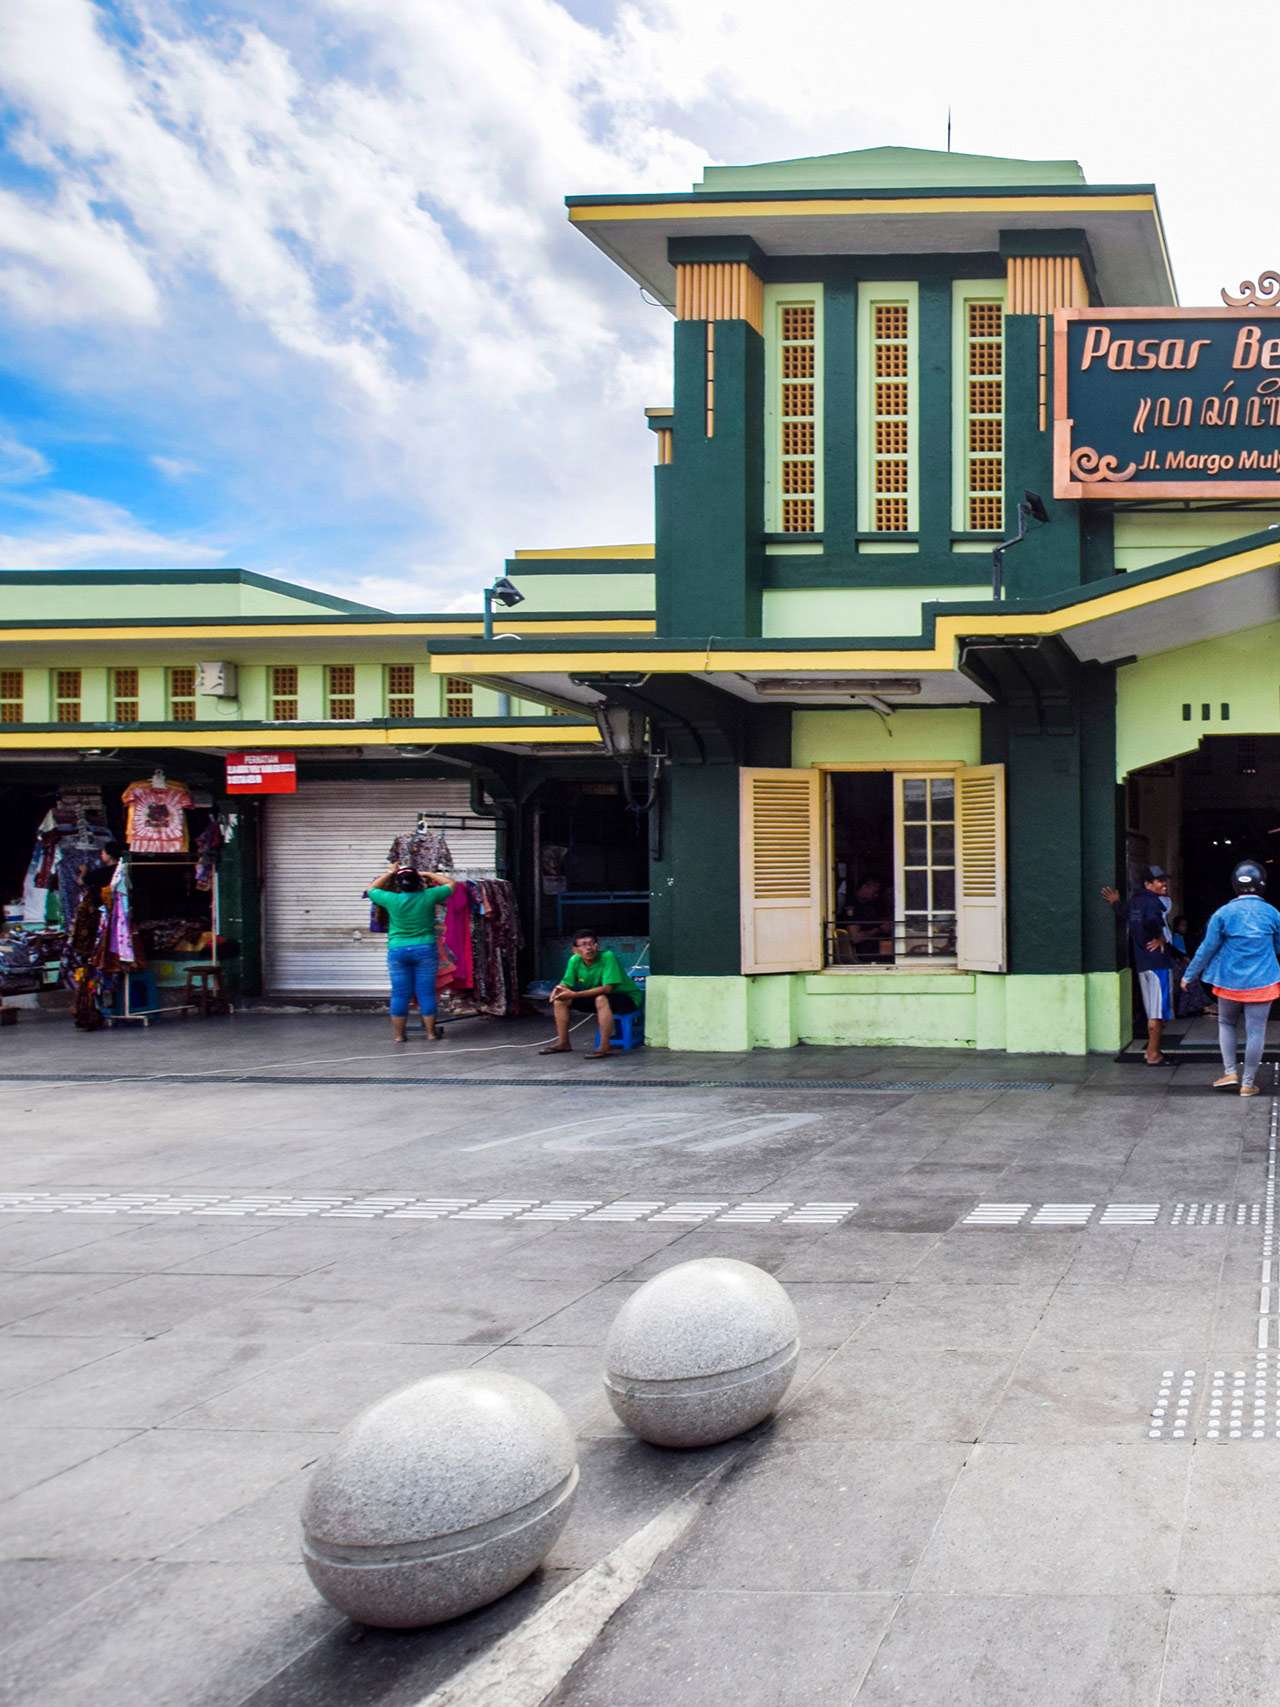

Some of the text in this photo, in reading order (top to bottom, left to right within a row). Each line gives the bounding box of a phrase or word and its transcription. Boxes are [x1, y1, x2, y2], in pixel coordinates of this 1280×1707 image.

[1081, 325, 1211, 371] Pasar
[1138, 450, 1160, 470] Jl.
[1165, 450, 1234, 474] Margo
